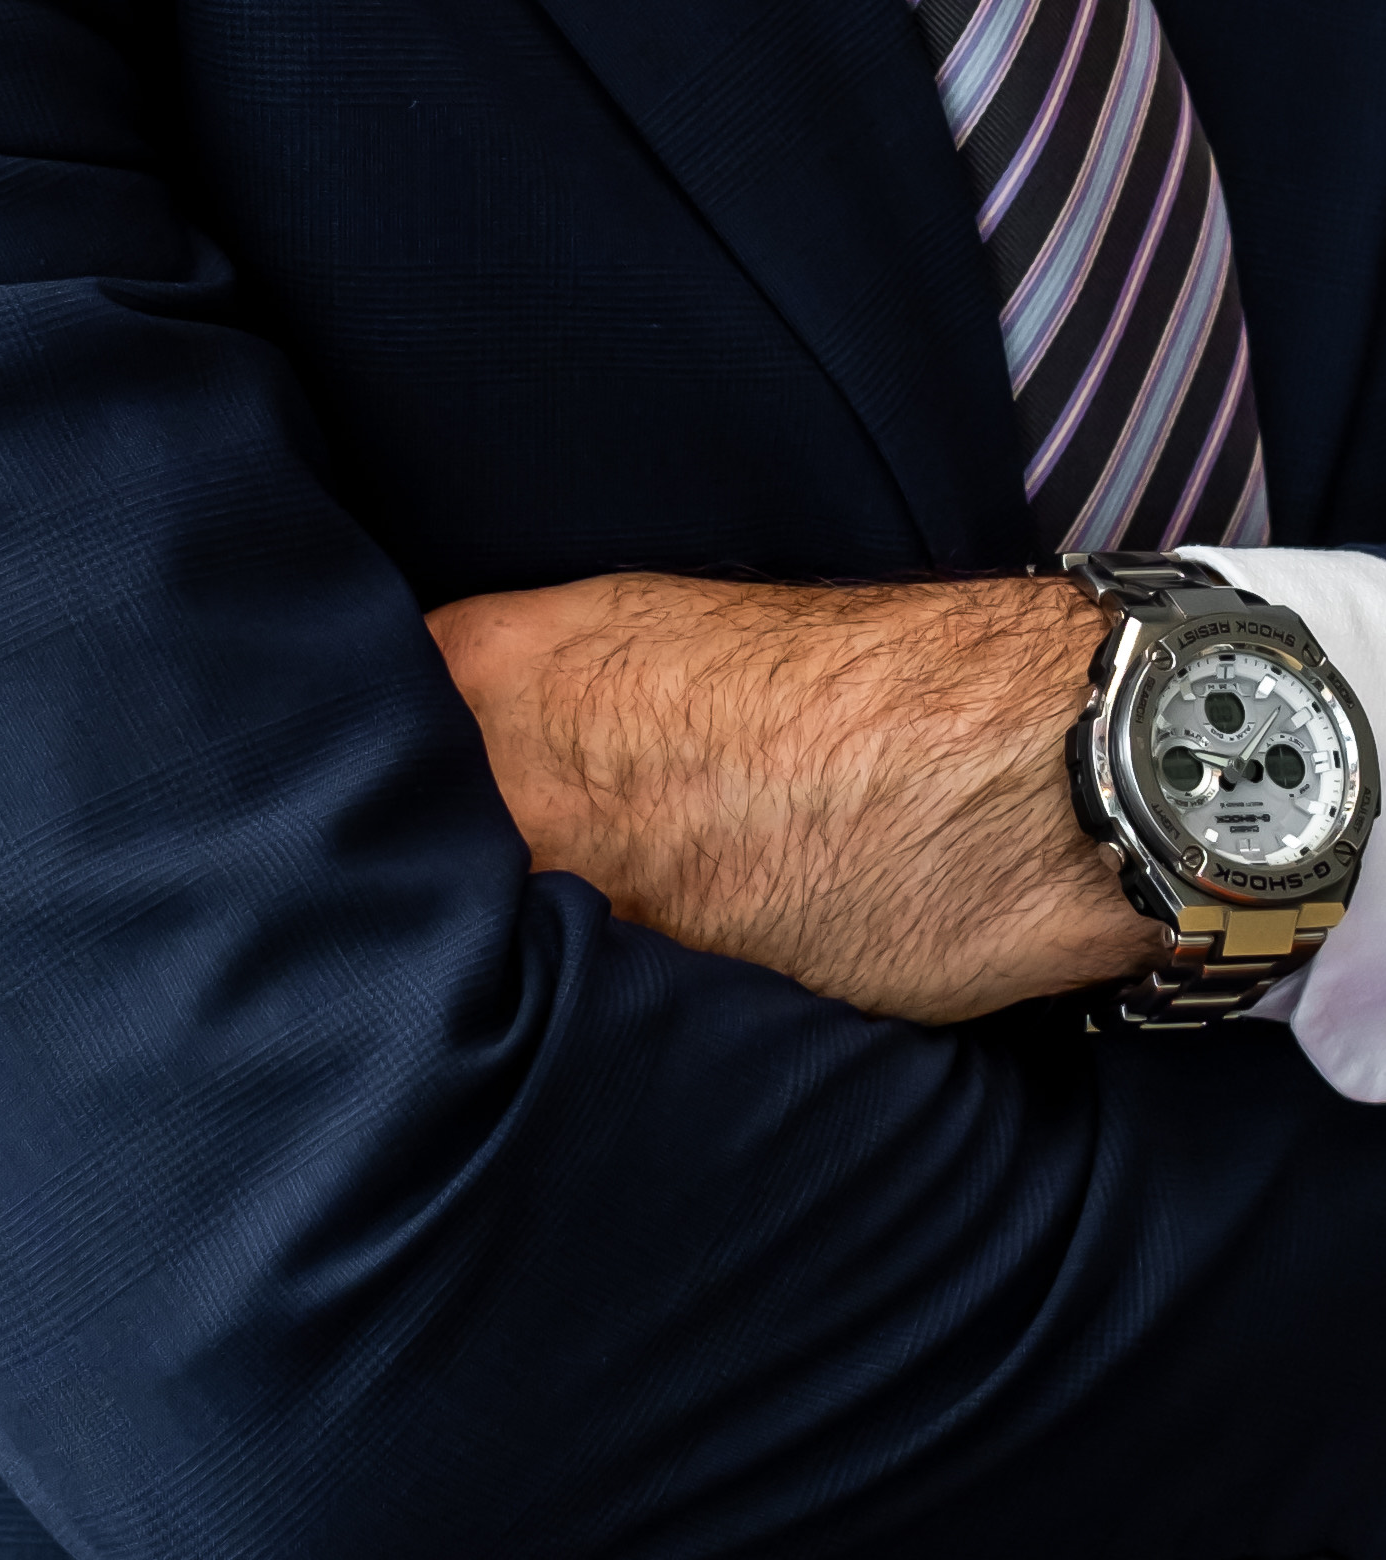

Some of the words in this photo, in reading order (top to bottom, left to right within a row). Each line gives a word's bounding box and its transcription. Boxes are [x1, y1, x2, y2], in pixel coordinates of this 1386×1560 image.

[1177, 620, 1231, 650] RESIST
[1235, 620, 1296, 647] SHOCK
[1215, 861, 1332, 891] G-SHOCK
